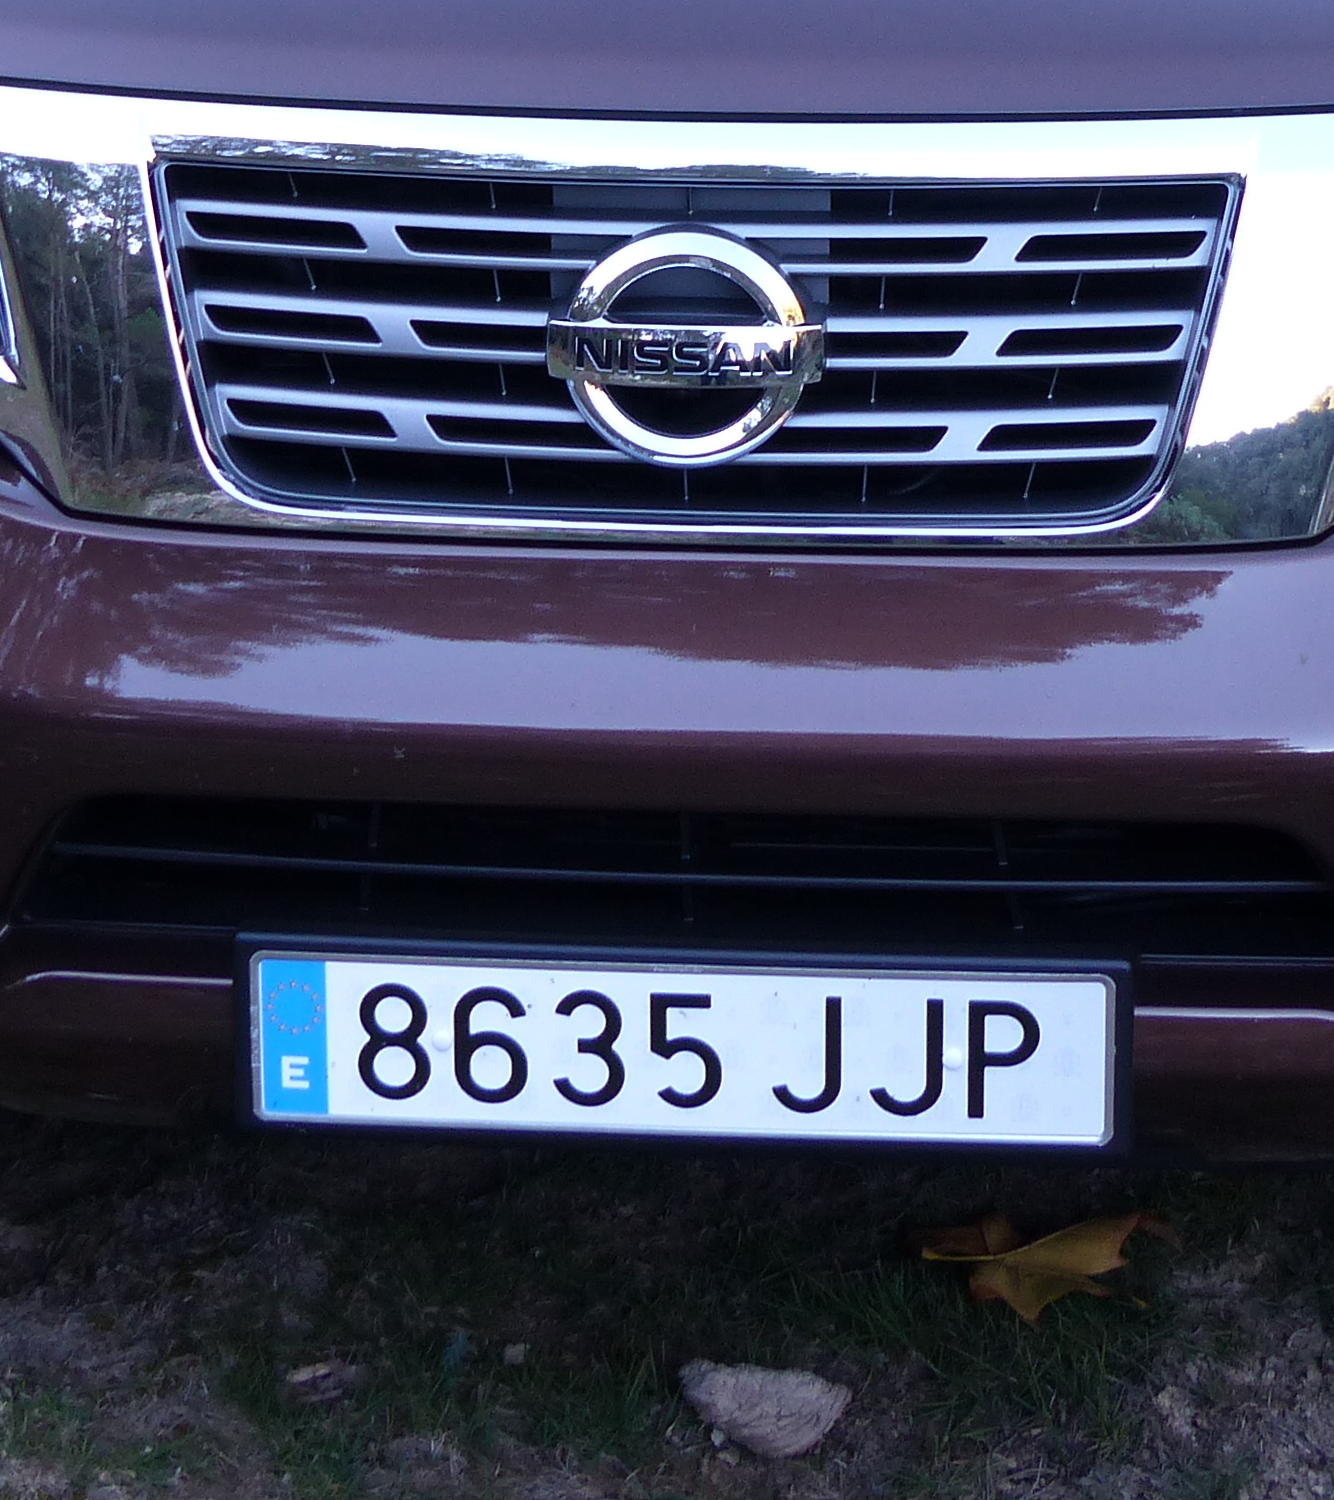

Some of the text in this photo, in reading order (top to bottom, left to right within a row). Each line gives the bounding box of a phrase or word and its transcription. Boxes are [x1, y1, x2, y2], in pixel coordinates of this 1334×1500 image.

[574, 336, 793, 377] NISSAN
[357, 983, 723, 1108] 8635
[771, 996, 1042, 1119] JJP
[281, 1055, 310, 1090] E
